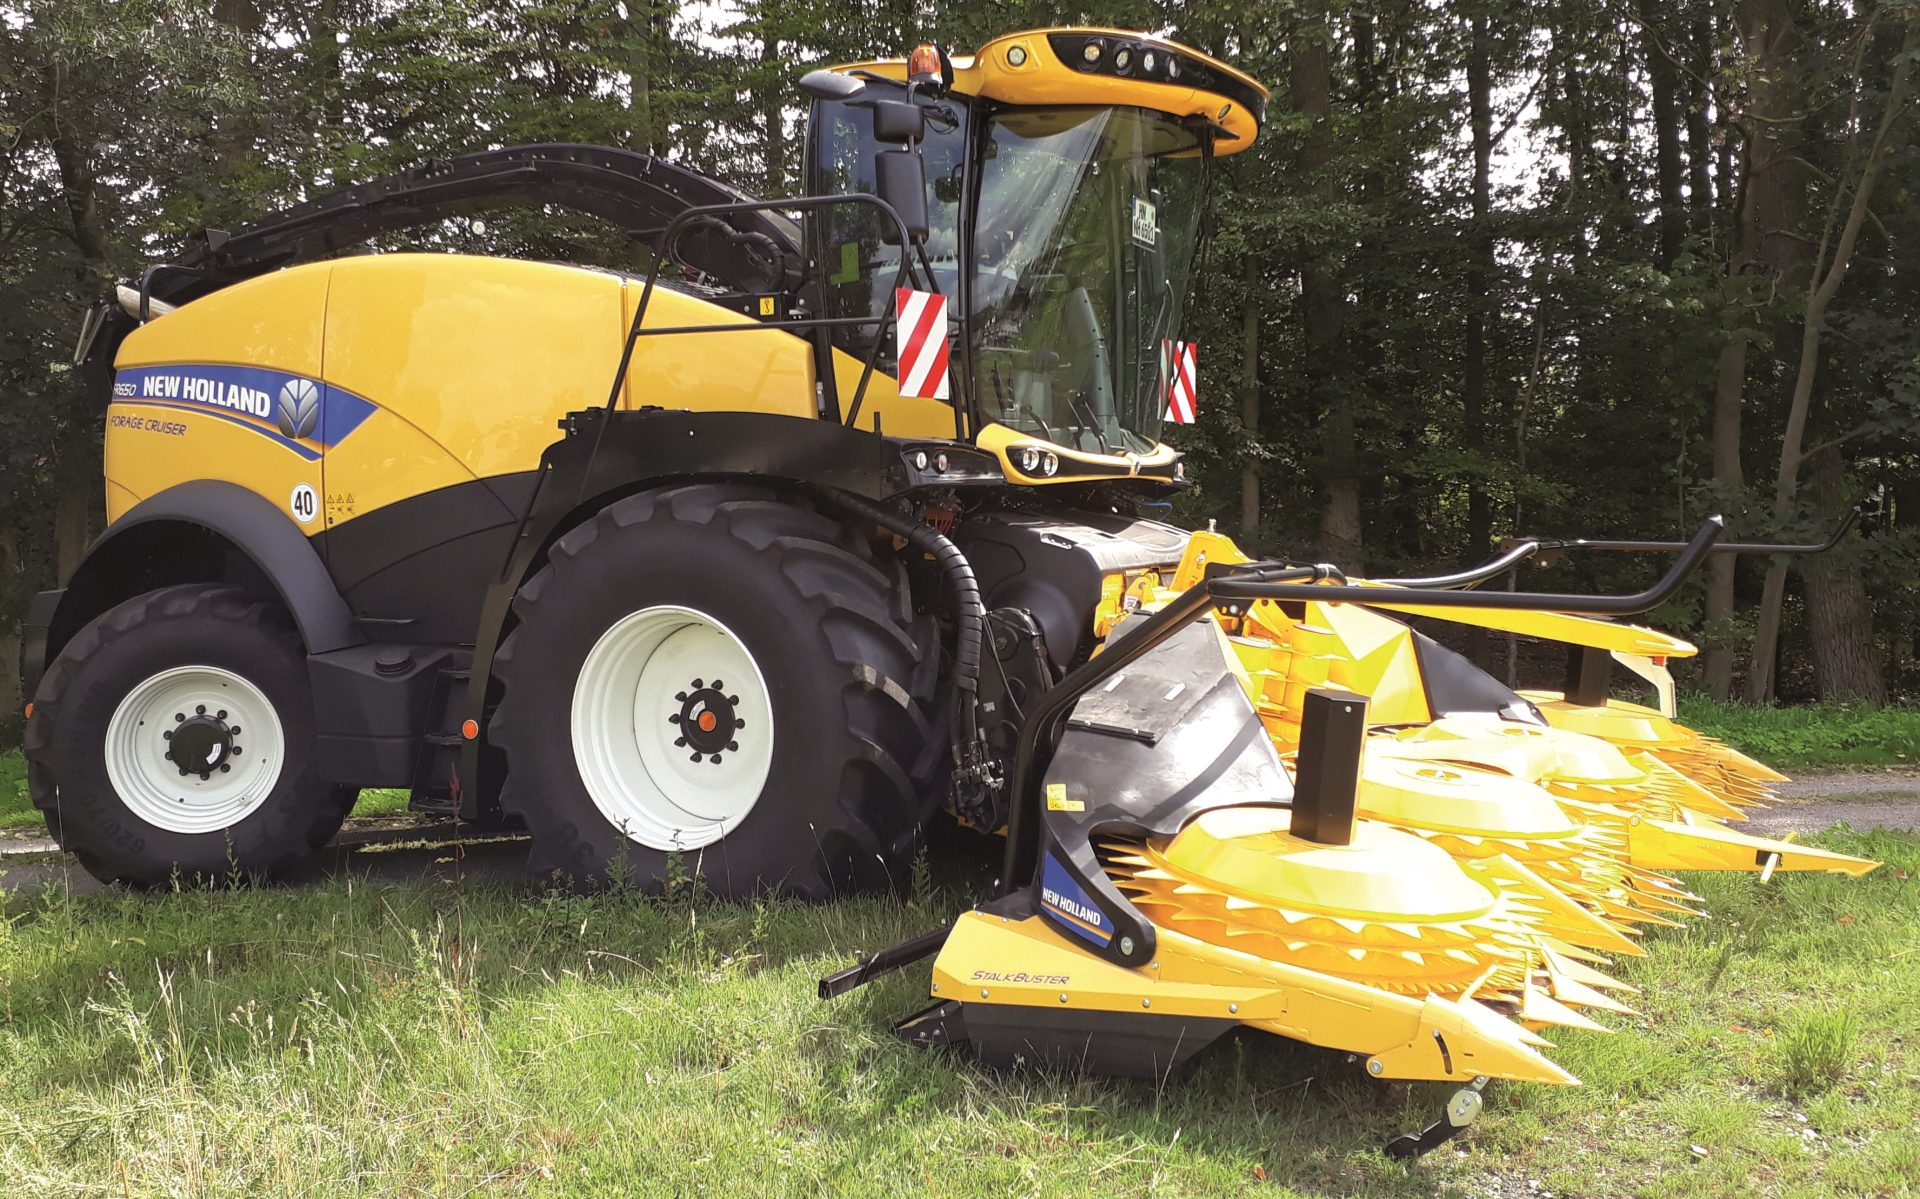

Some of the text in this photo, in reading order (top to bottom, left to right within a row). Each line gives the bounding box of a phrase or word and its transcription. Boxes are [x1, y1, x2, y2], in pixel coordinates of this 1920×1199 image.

[143, 376, 271, 418] NEW HOLLAND
[111, 415, 187, 436] FORAGE CRUISER
[294, 490, 313, 516] 40
[1042, 887, 1101, 926] NEW HOLLAND
